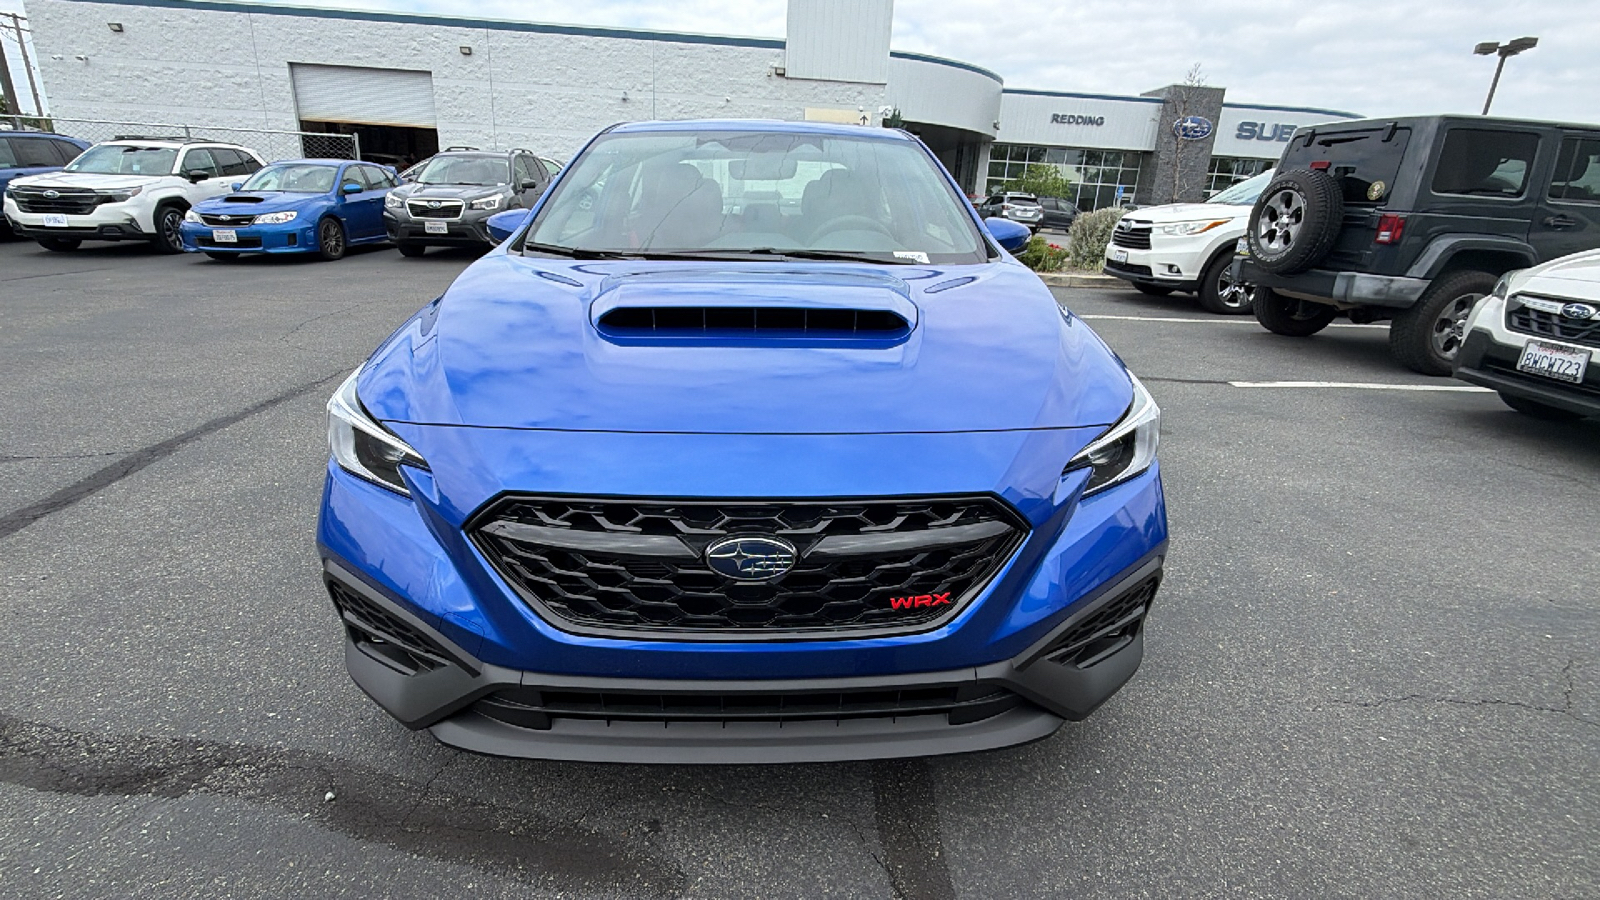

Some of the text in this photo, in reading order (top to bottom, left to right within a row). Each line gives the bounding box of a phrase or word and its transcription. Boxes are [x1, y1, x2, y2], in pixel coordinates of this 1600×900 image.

[1050, 113, 1105, 126] REDDING
[1524, 352, 1581, 377] 8WCW723
[890, 592, 950, 609] WRX
